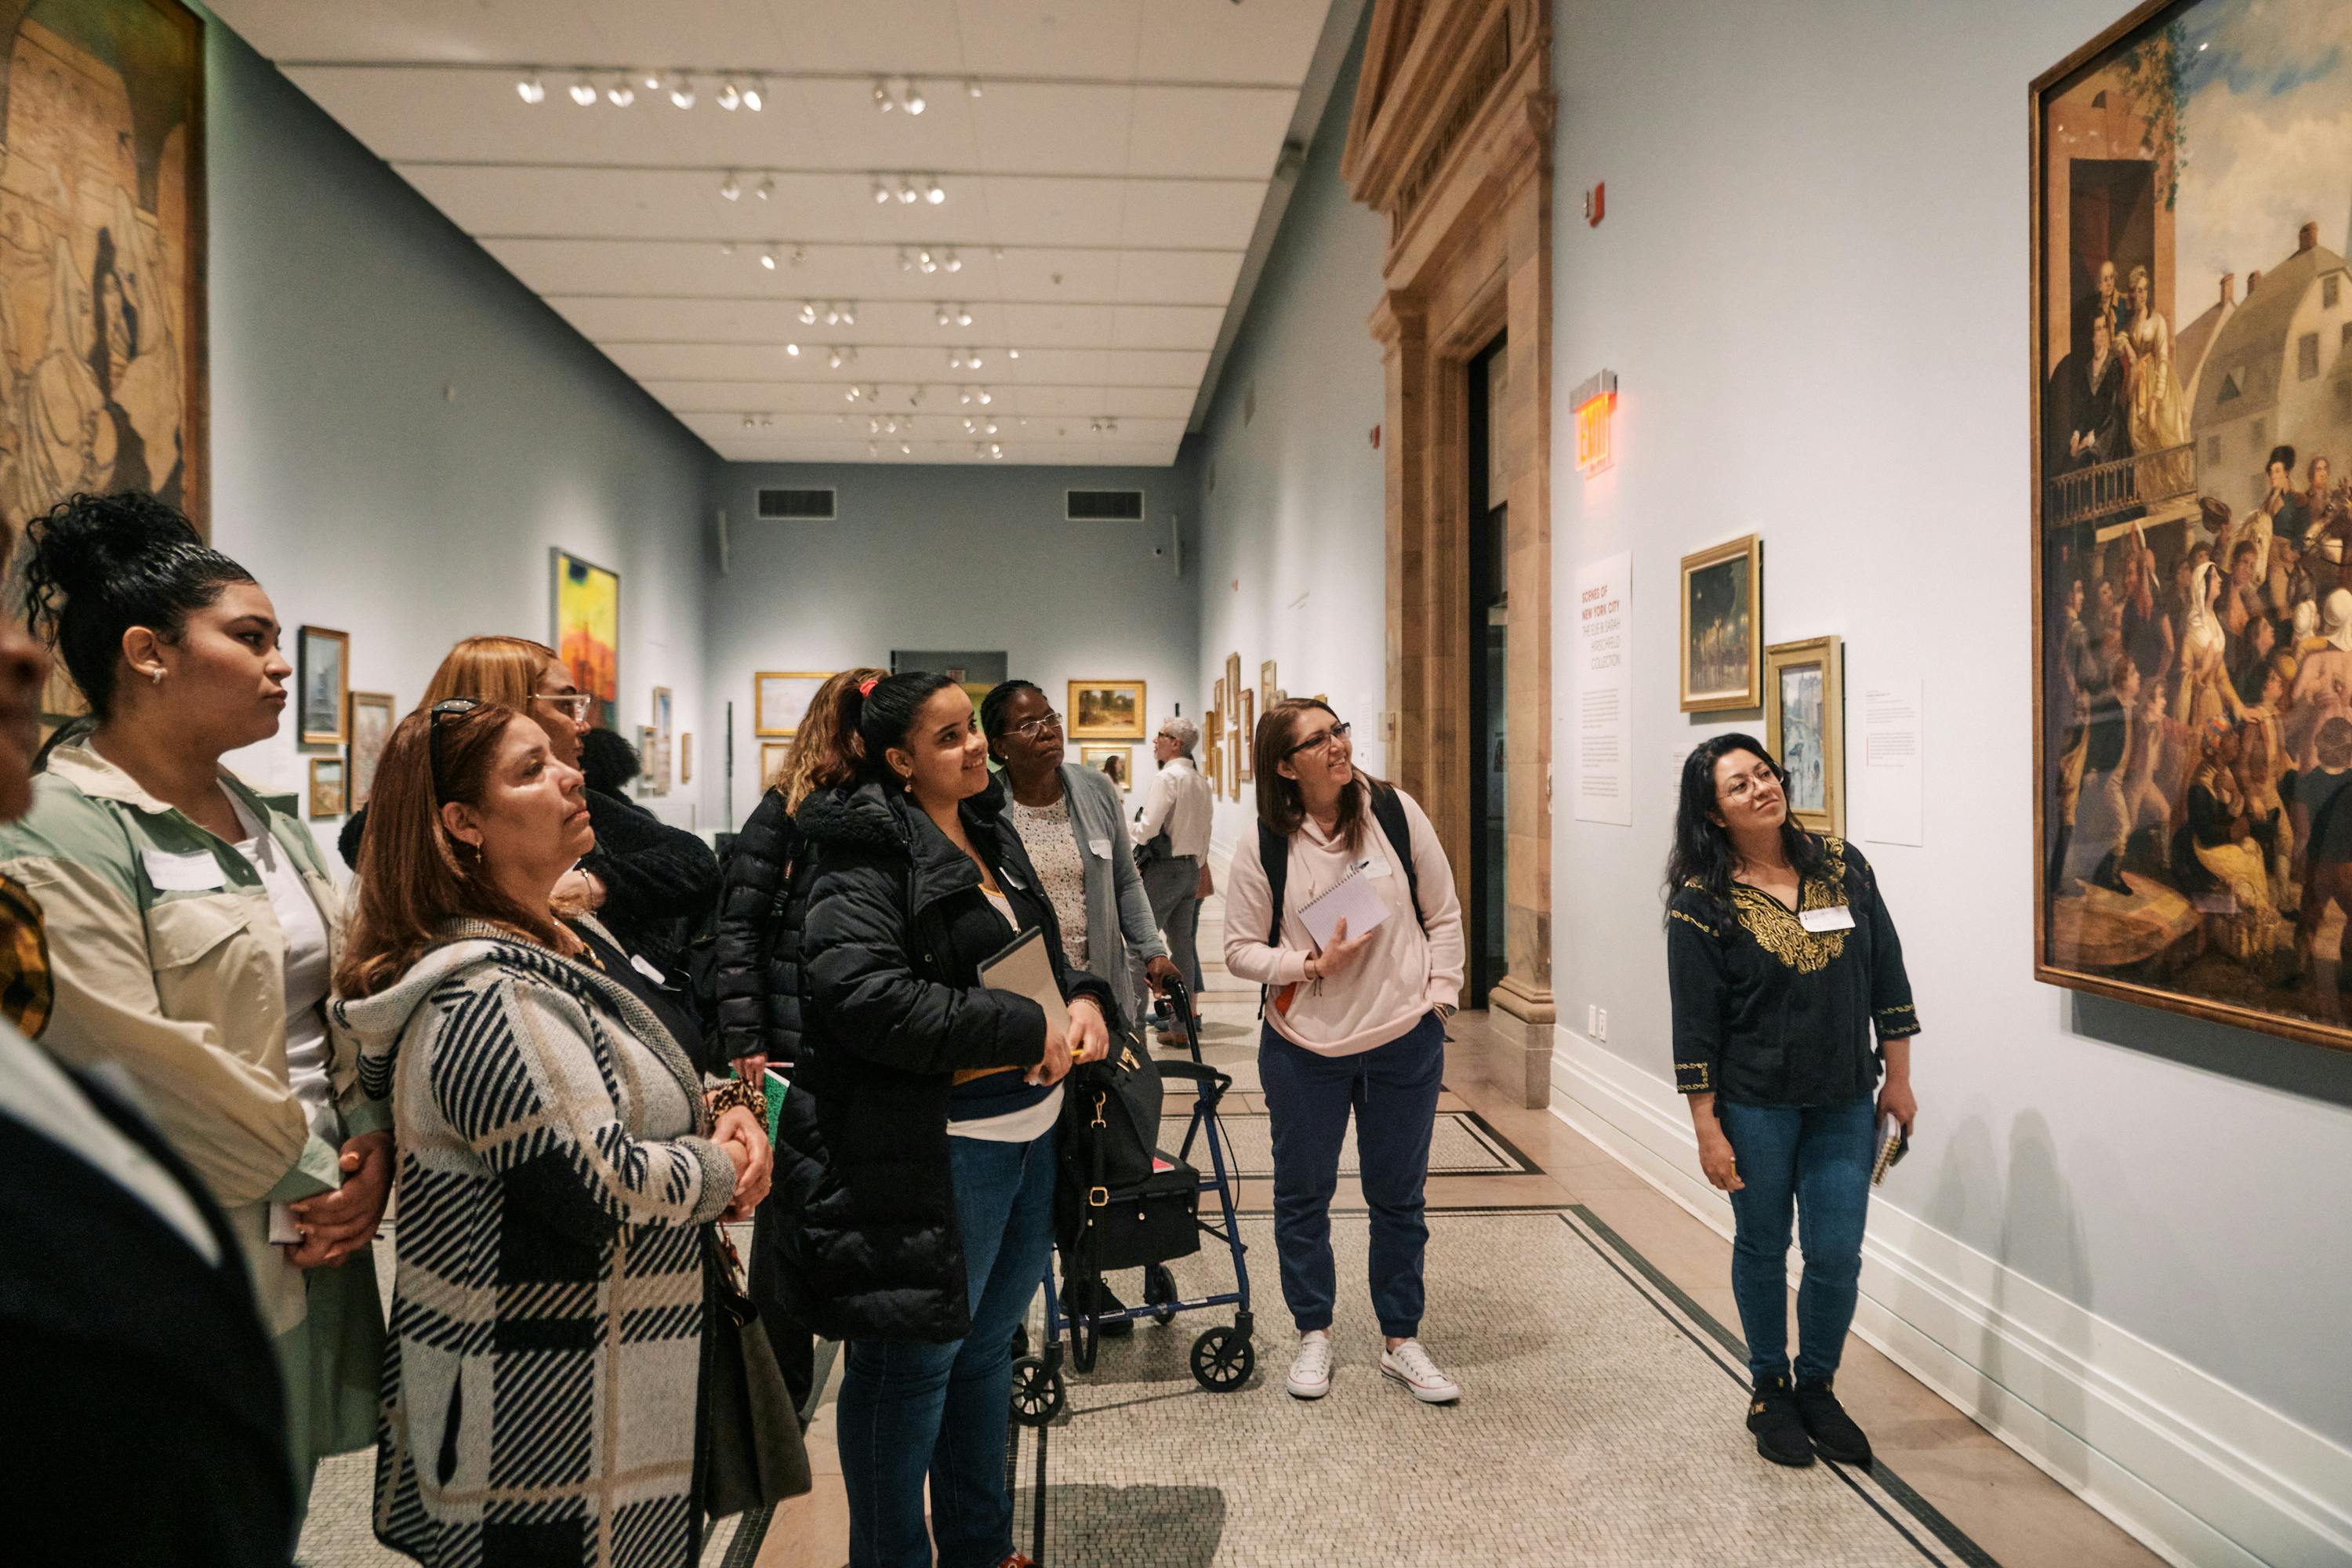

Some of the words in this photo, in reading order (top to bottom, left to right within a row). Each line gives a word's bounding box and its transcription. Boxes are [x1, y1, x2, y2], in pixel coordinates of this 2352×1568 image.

[1582, 588, 1600, 603] SCENES
[1600, 585, 1607, 597] OF
[1582, 608, 1592, 620] NEW
[1594, 604, 1606, 616] YORK
[1608, 601, 1620, 613] CITY
[1581, 625, 1590, 637] THE
[1605, 618, 1621, 633] SARAH
[1592, 654, 1621, 670] COLLECTION
